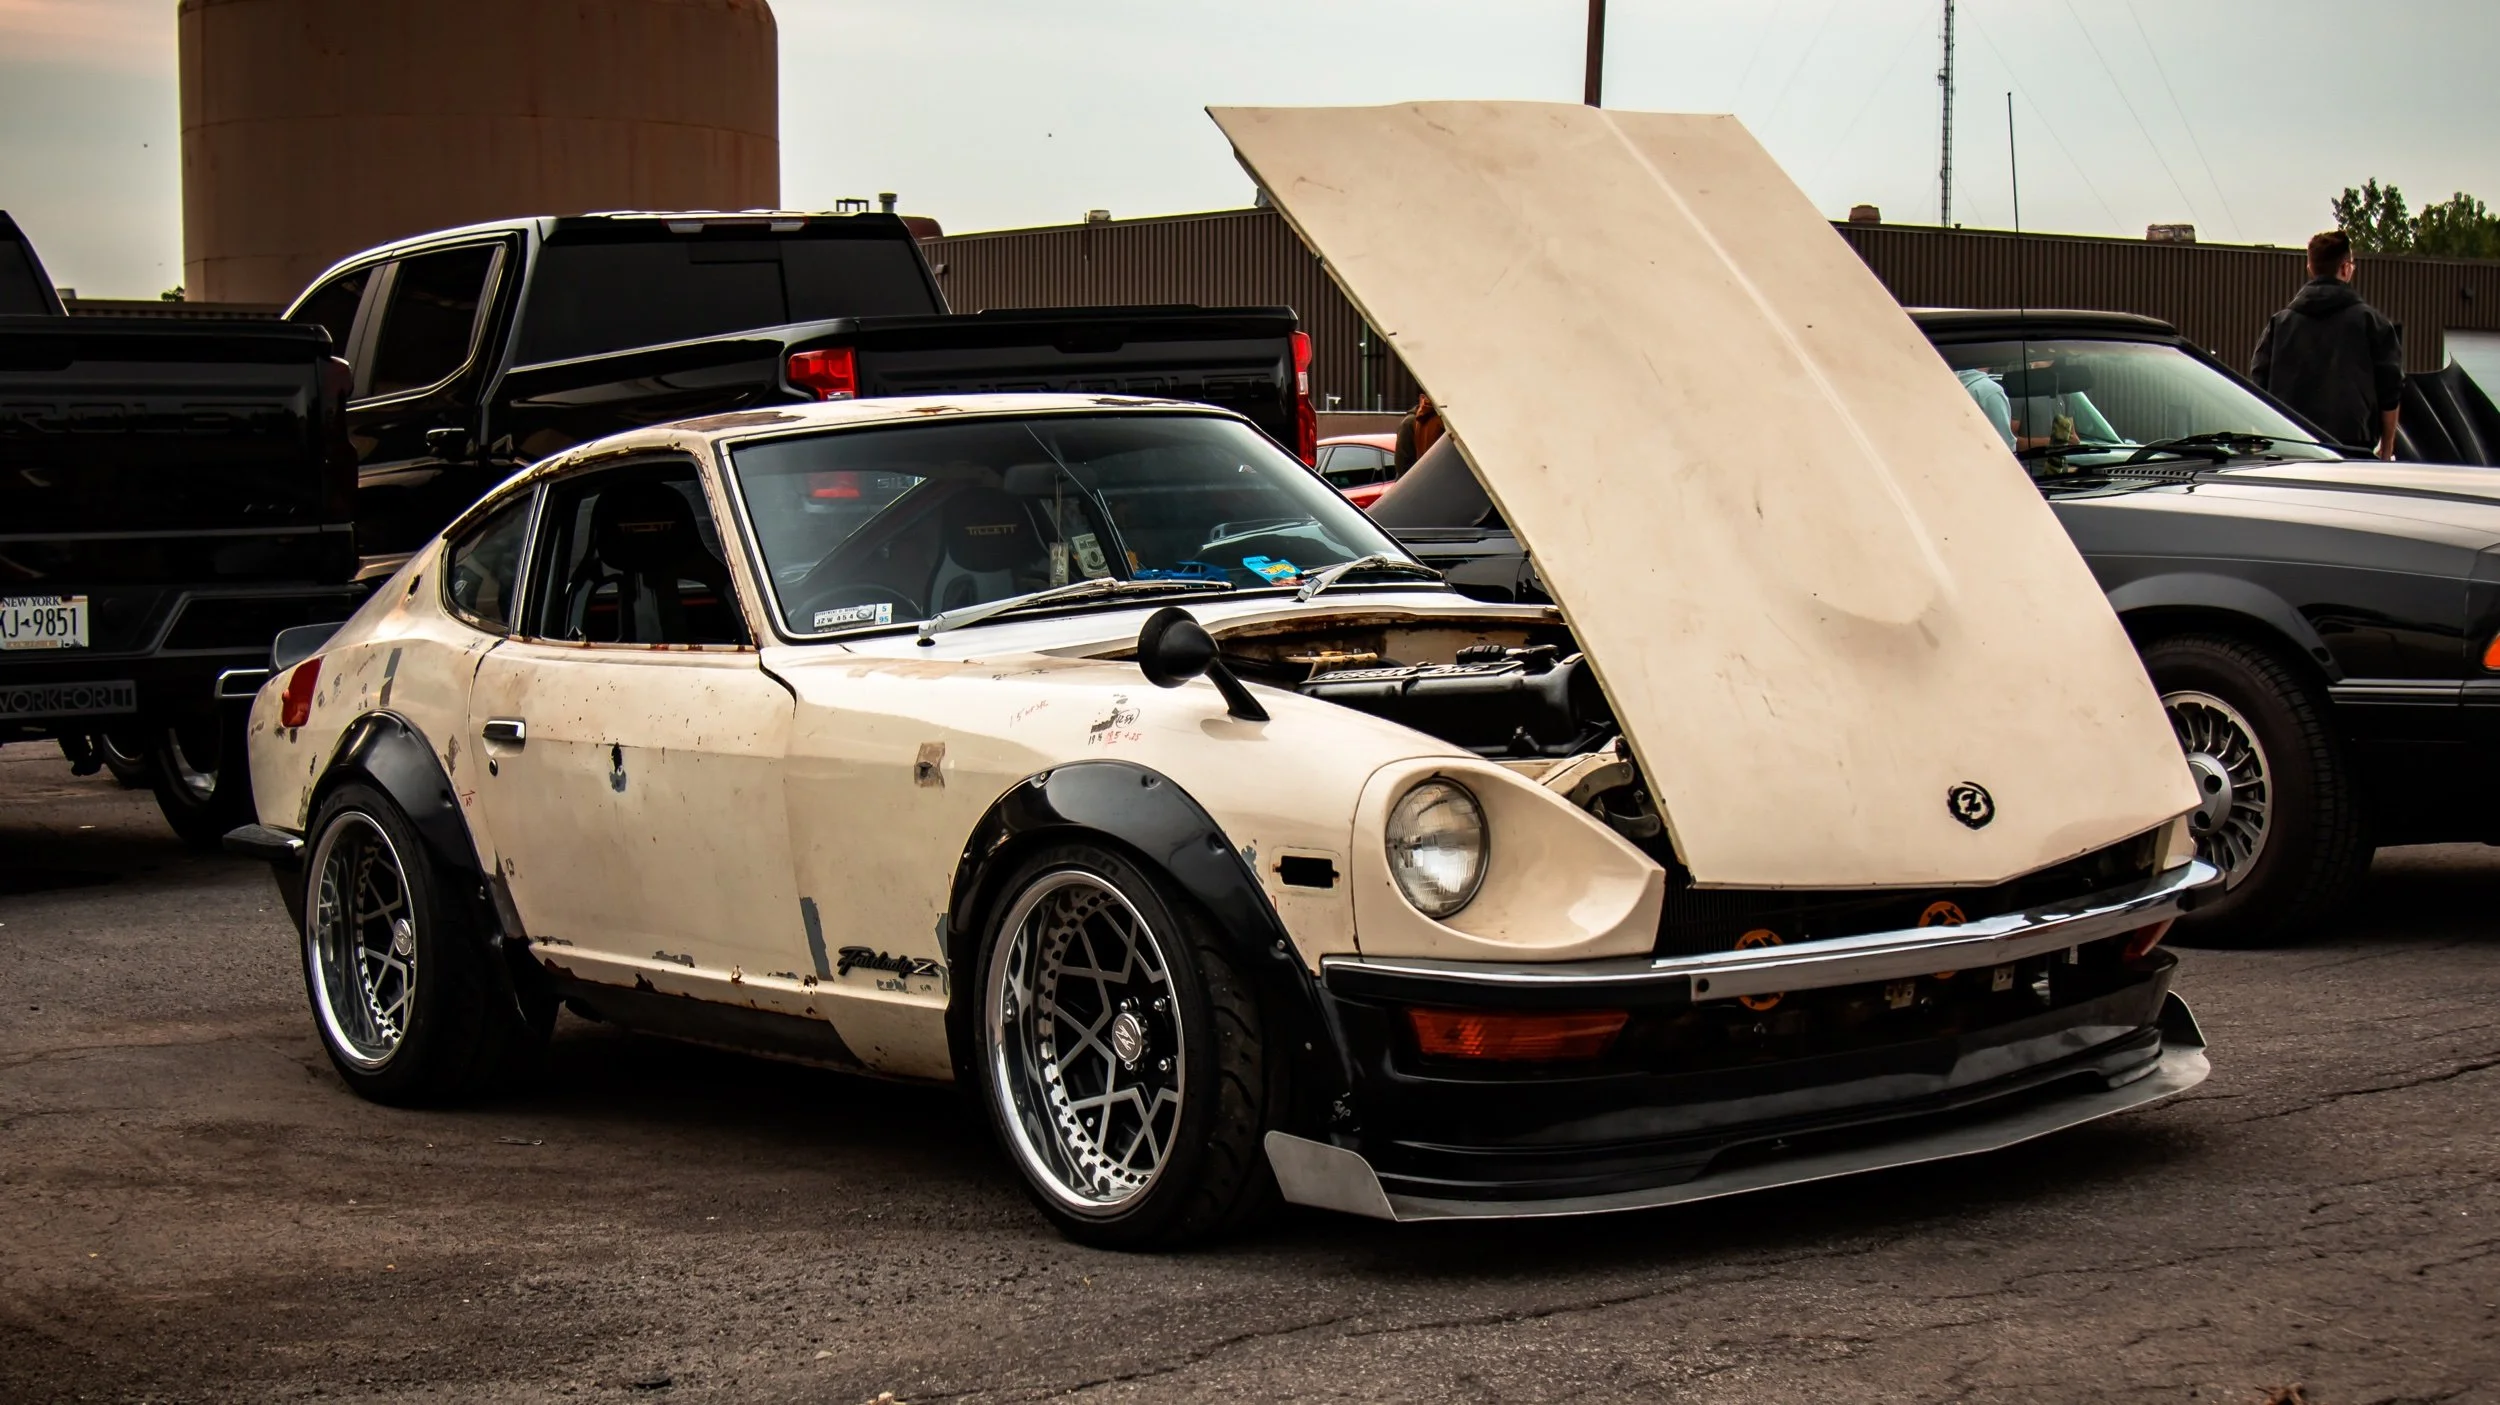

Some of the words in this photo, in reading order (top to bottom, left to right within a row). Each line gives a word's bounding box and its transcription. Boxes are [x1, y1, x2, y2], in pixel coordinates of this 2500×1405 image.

[2, 597, 28, 608] NEW
[31, 595, 60, 607] YORK
[878, 615, 889, 623] 95
